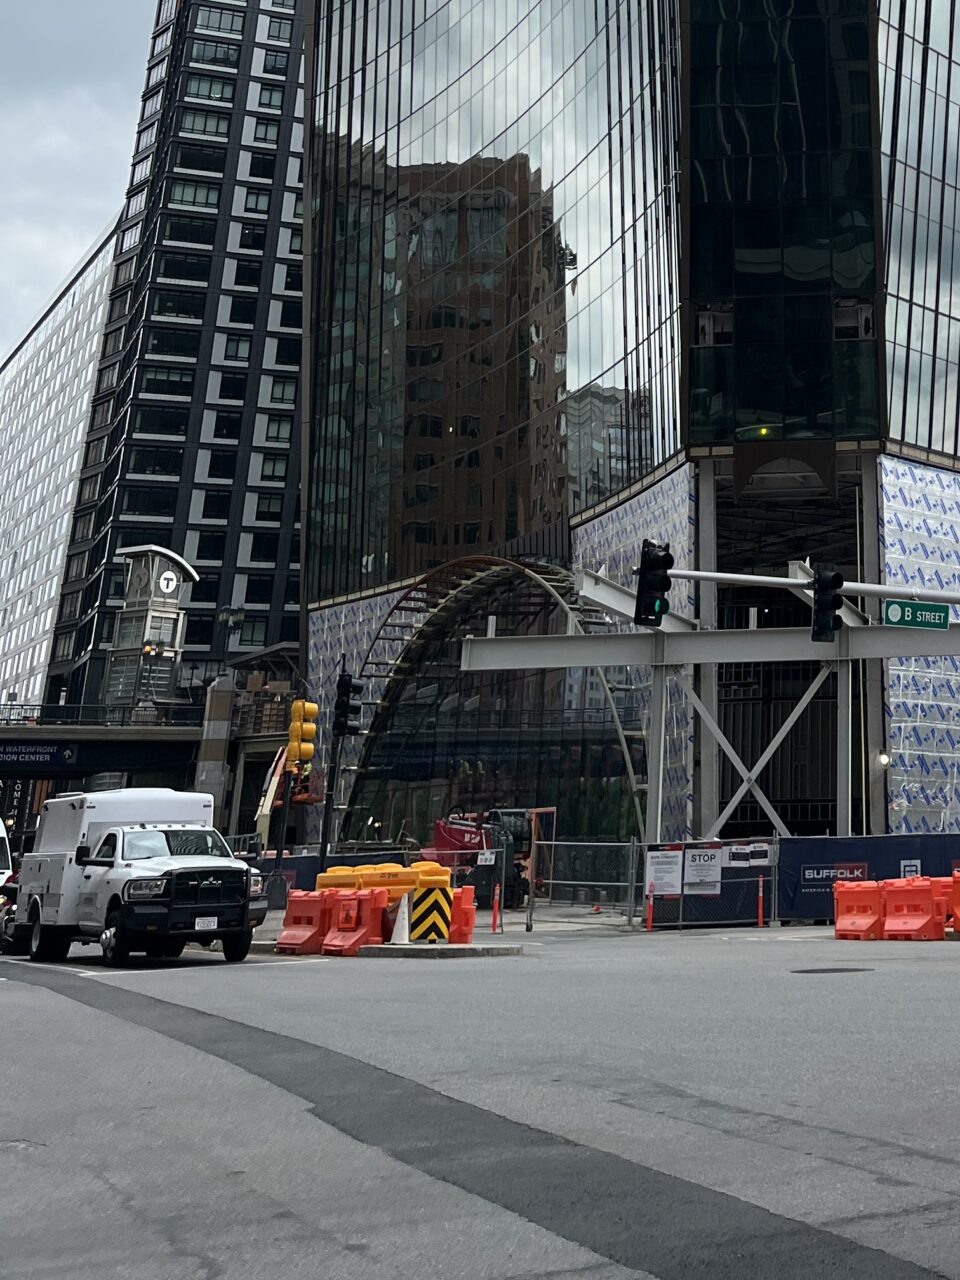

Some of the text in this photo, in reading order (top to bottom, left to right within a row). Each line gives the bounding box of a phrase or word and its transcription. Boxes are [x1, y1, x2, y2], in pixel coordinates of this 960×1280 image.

[163, 576, 174, 590] T
[904, 607, 945, 624] B STREET
[5, 745, 58, 753] WATERFRONT
[690, 853, 717, 863] STOP
[804, 869, 863, 879] SUFFOLK
